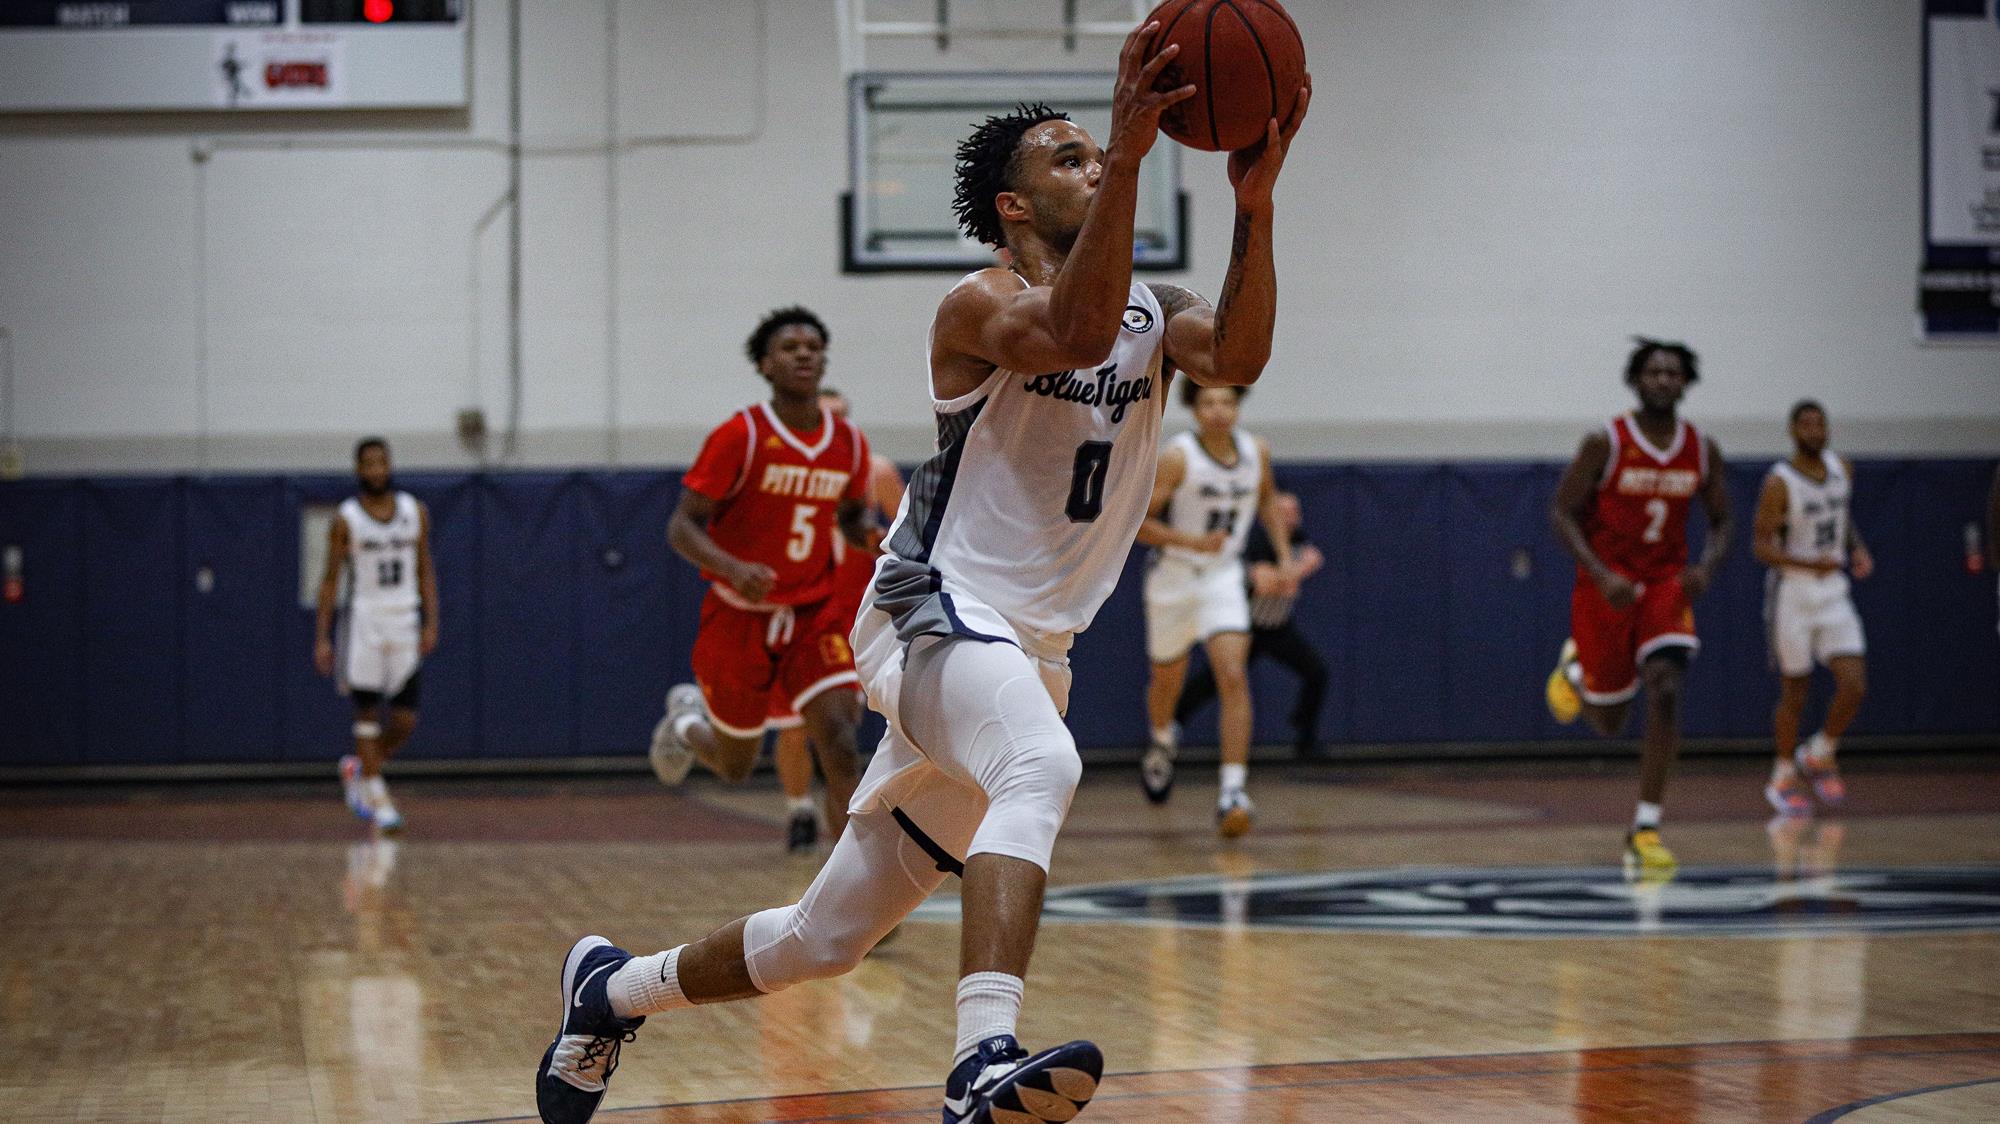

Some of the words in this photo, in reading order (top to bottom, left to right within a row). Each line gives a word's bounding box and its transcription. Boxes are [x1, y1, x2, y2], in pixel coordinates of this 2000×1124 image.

[1064, 440, 1114, 523] 0
[786, 504, 818, 562] 5
[1641, 499, 1669, 544] 2
